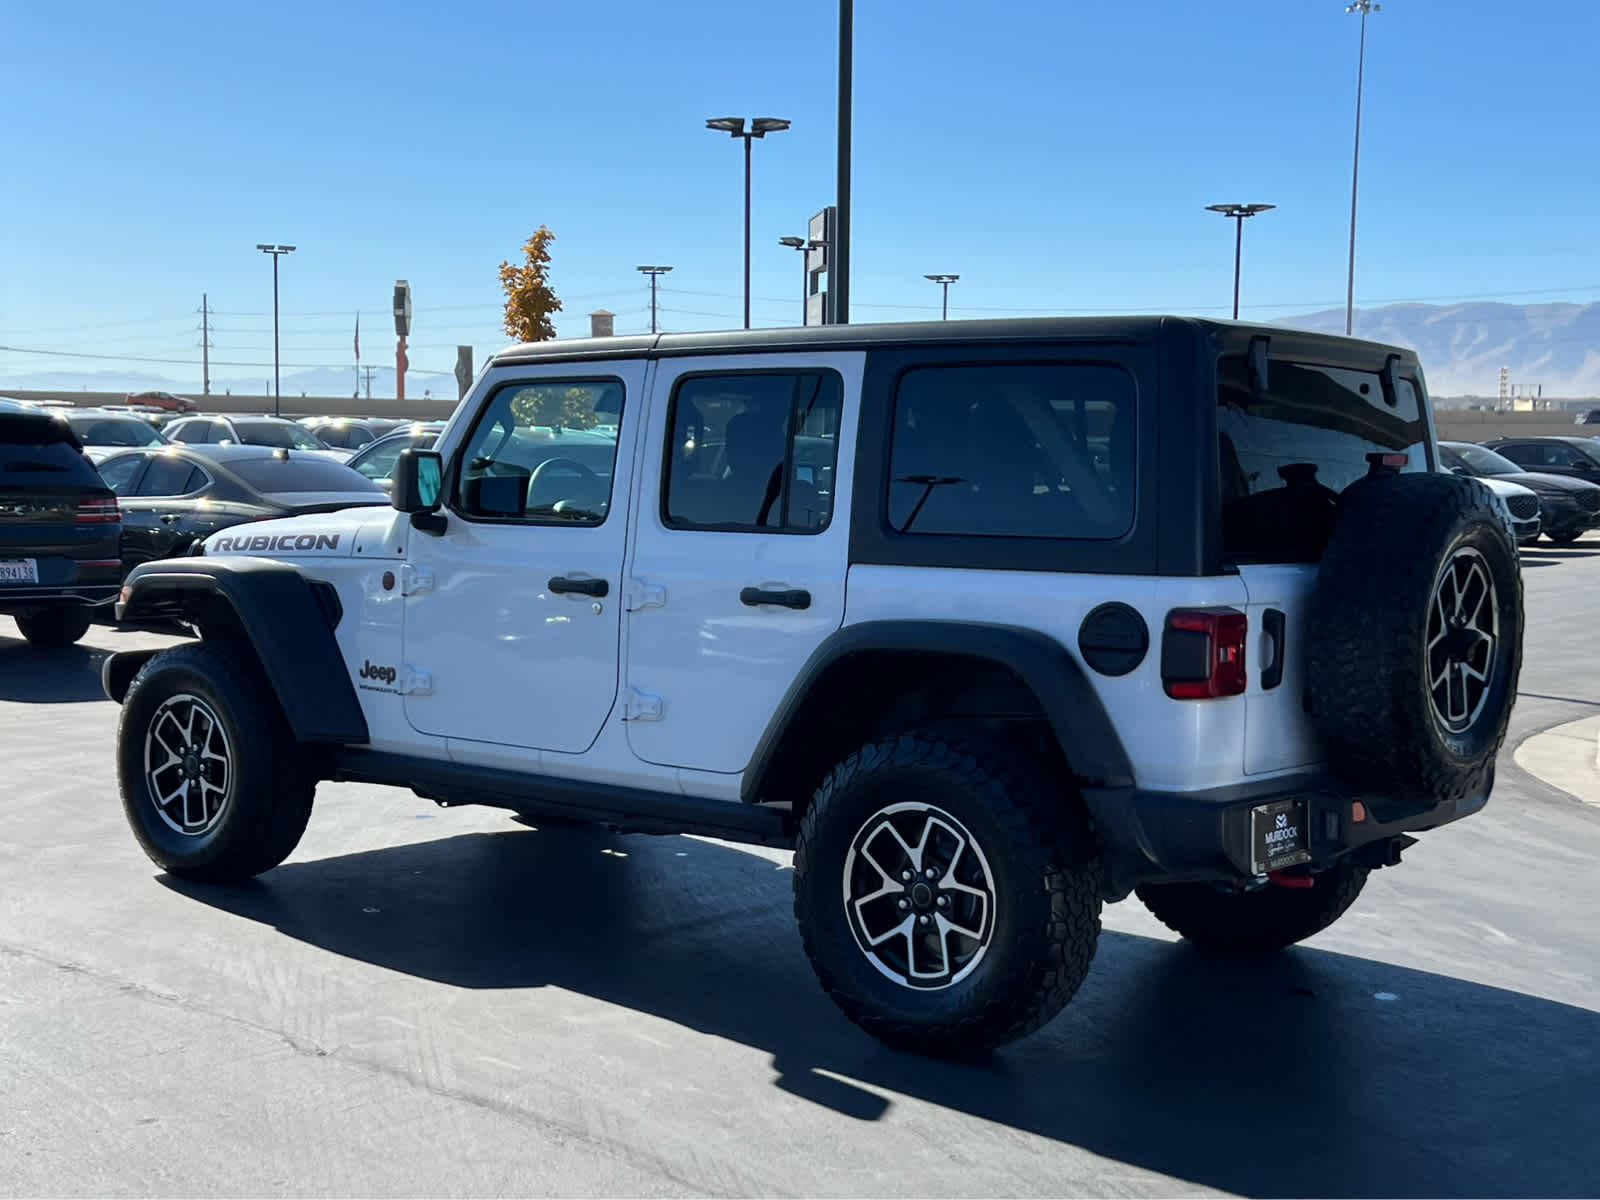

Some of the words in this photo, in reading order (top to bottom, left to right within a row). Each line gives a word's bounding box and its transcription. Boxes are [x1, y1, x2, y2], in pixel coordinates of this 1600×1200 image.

[213, 534, 340, 552] RUBICON
[360, 659, 397, 685] Jeep
[1265, 826, 1298, 844] MURDOCK
